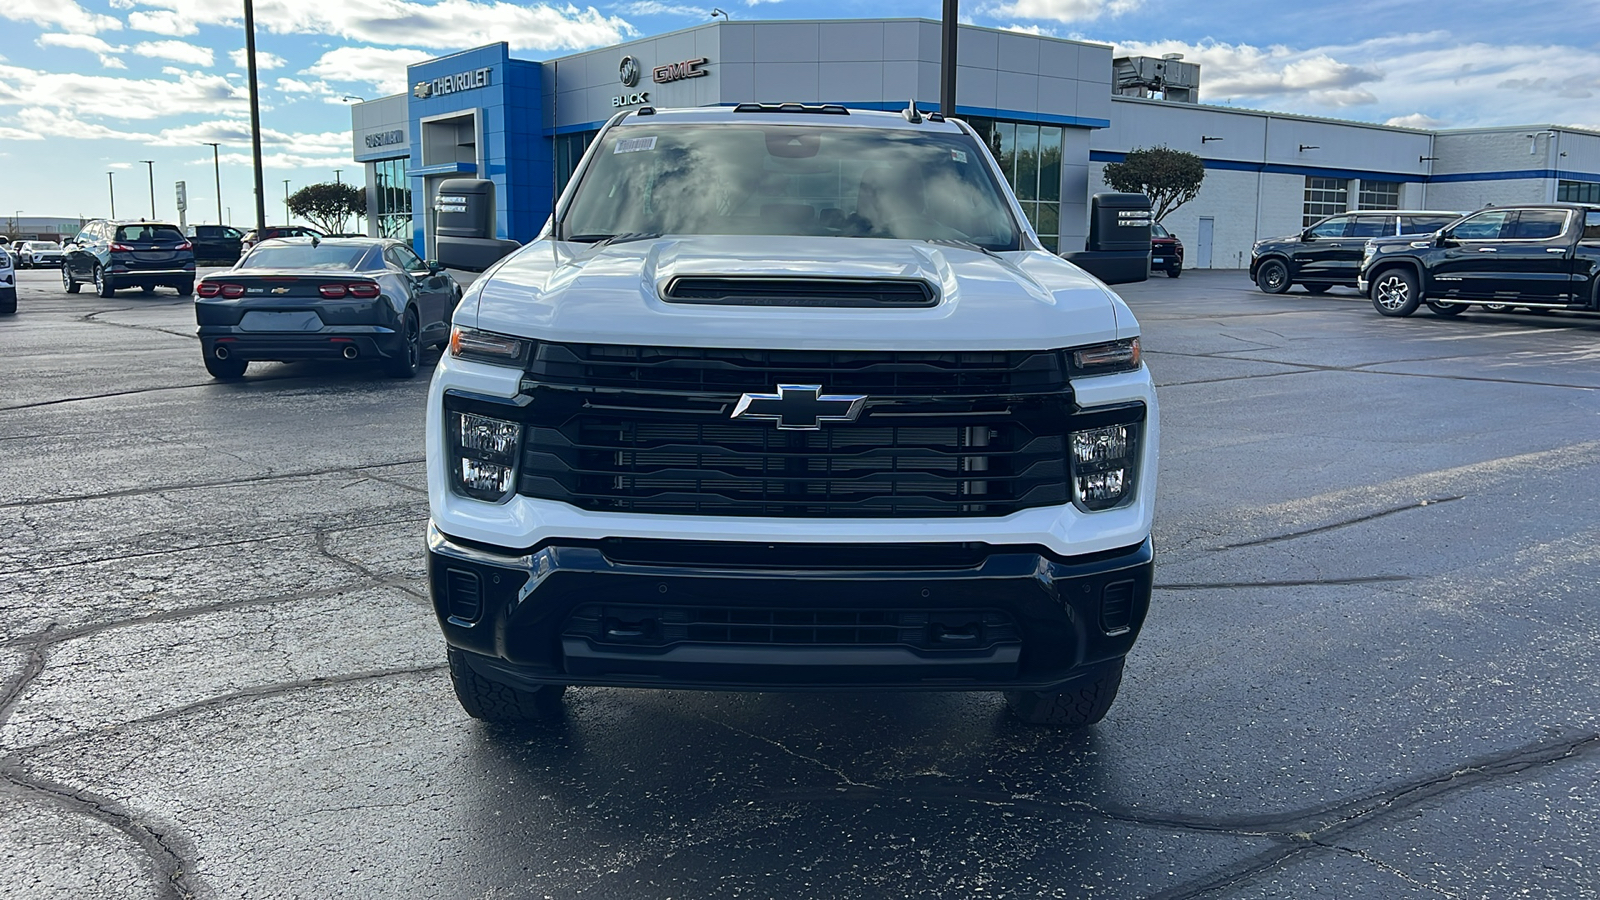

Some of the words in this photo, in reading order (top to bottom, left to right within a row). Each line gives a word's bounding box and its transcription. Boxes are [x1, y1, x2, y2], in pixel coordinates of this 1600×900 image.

[432, 67, 490, 96] CHEVROLET
[652, 58, 707, 84] GMC
[612, 91, 646, 107] BUICK
